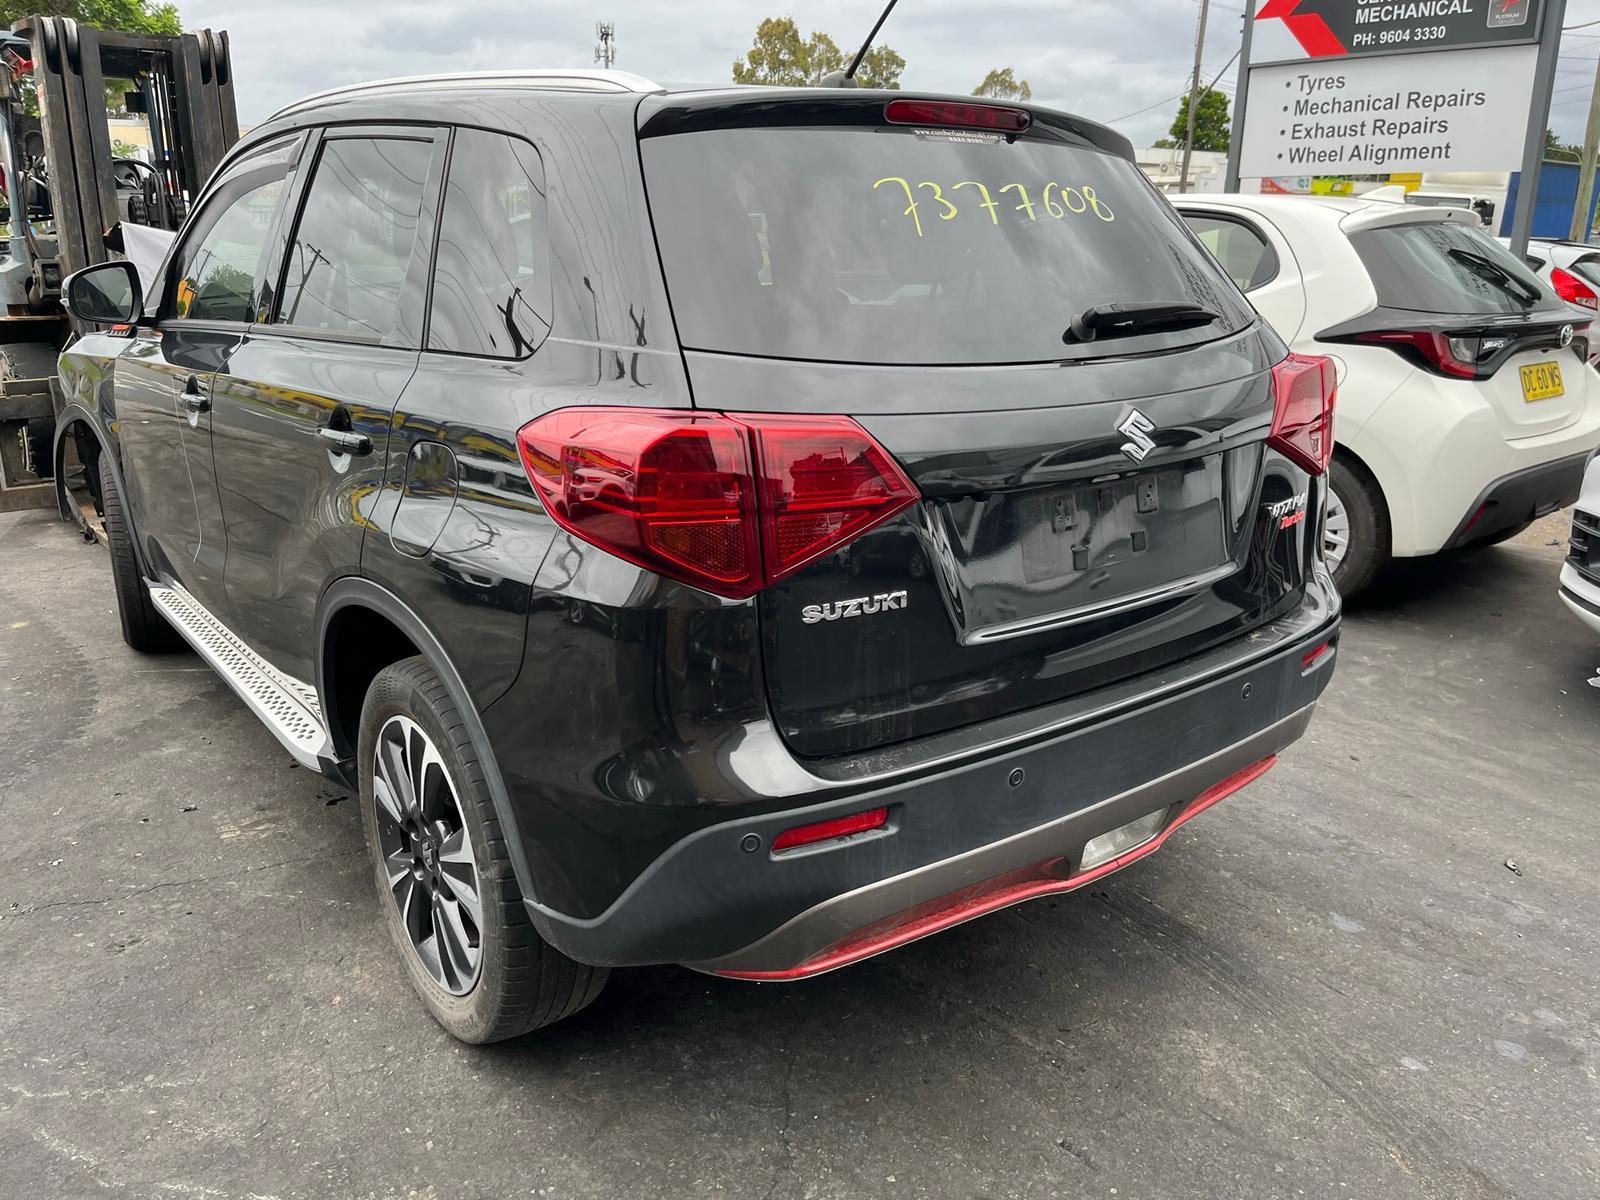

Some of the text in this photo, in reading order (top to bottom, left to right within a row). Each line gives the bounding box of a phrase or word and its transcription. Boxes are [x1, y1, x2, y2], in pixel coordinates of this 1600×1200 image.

[1355, 0, 1473, 24] MECHANICAL
[1353, 26, 1447, 46] PH: 9604 3330
[1298, 75, 1346, 95] Tyres
[1294, 89, 1486, 116] Mechanical Repairs
[1291, 116, 1449, 140] Exhaust Repairs
[1289, 142, 1451, 165] Wheel Alignment
[873, 177, 1115, 237] 7377608
[801, 590, 908, 624] SUZUKI
